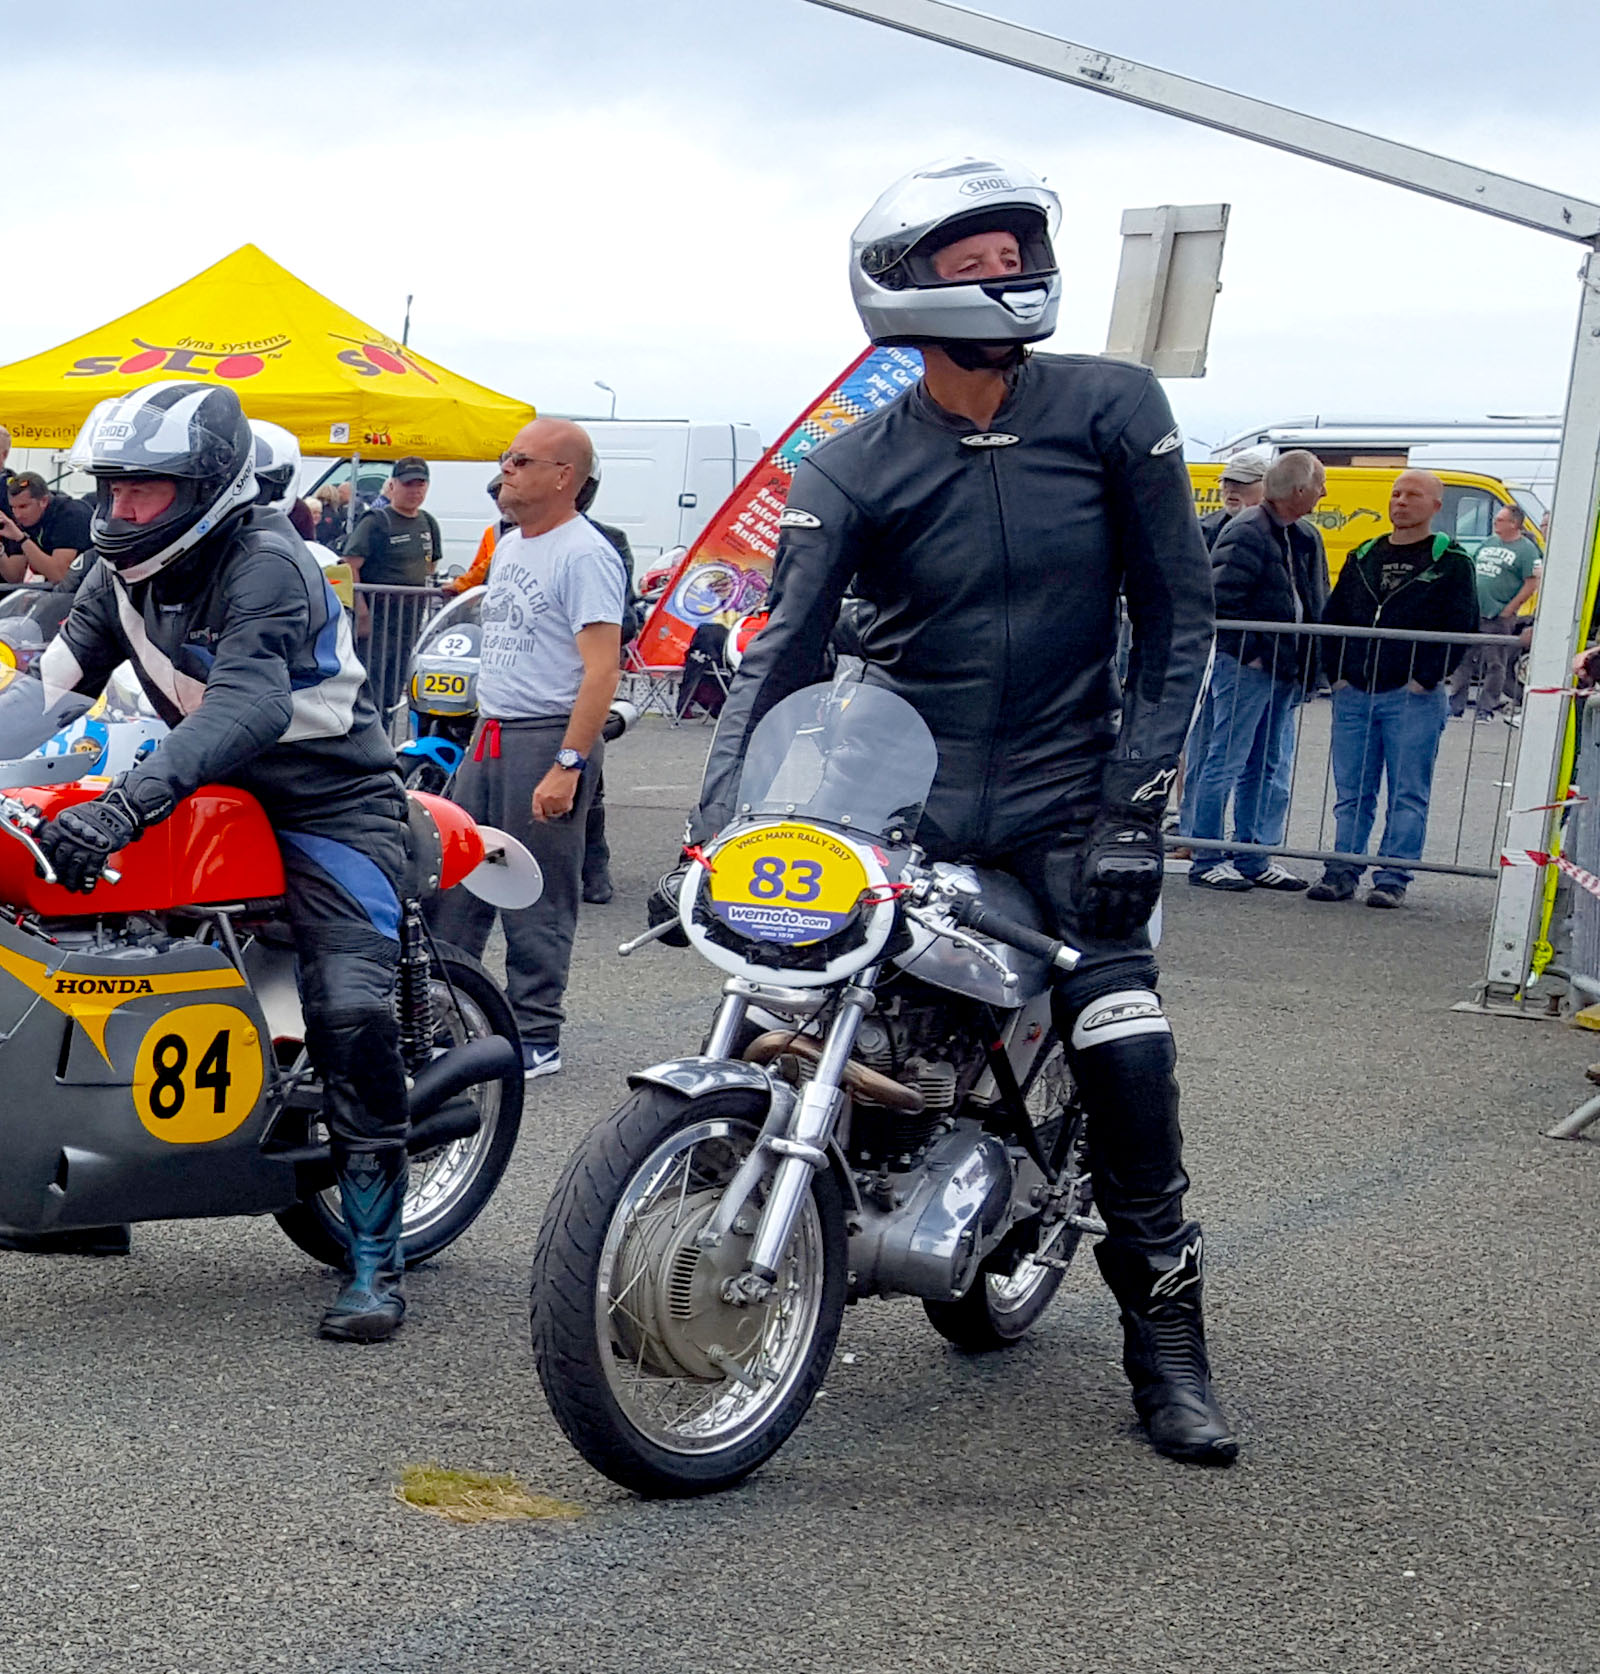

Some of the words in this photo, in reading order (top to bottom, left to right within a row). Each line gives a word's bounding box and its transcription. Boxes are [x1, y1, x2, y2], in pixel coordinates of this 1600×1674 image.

[175, 336, 215, 351] dyna
[220, 333, 287, 351] systems
[445, 638, 464, 650] 32
[424, 674, 466, 695] 250
[736, 834, 764, 851] VMCC
[765, 831, 796, 841] MANX
[796, 832, 828, 848] RALLY
[828, 843, 852, 863] 2017
[748, 855, 824, 903] 83
[731, 906, 829, 929] wemoto.com
[54, 979, 154, 995] HONDA
[149, 1028, 232, 1120] 84
